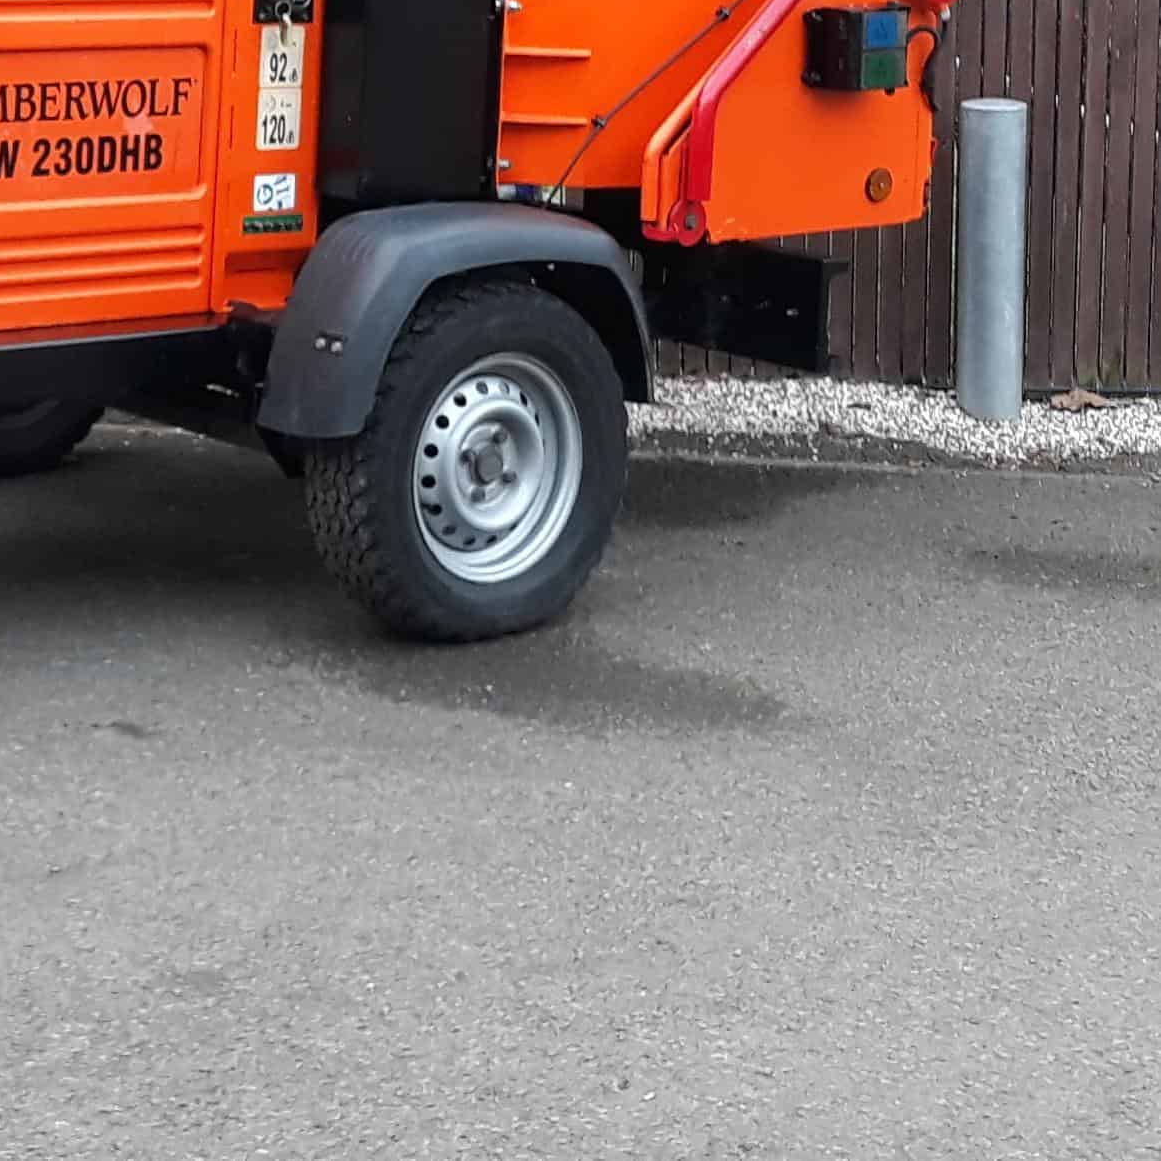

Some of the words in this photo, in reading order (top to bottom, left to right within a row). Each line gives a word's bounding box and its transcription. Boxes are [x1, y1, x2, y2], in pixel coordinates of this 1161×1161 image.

[269, 52, 288, 83] 92
[261, 113, 286, 145] 120
[30, 133, 164, 178] 230DHB
